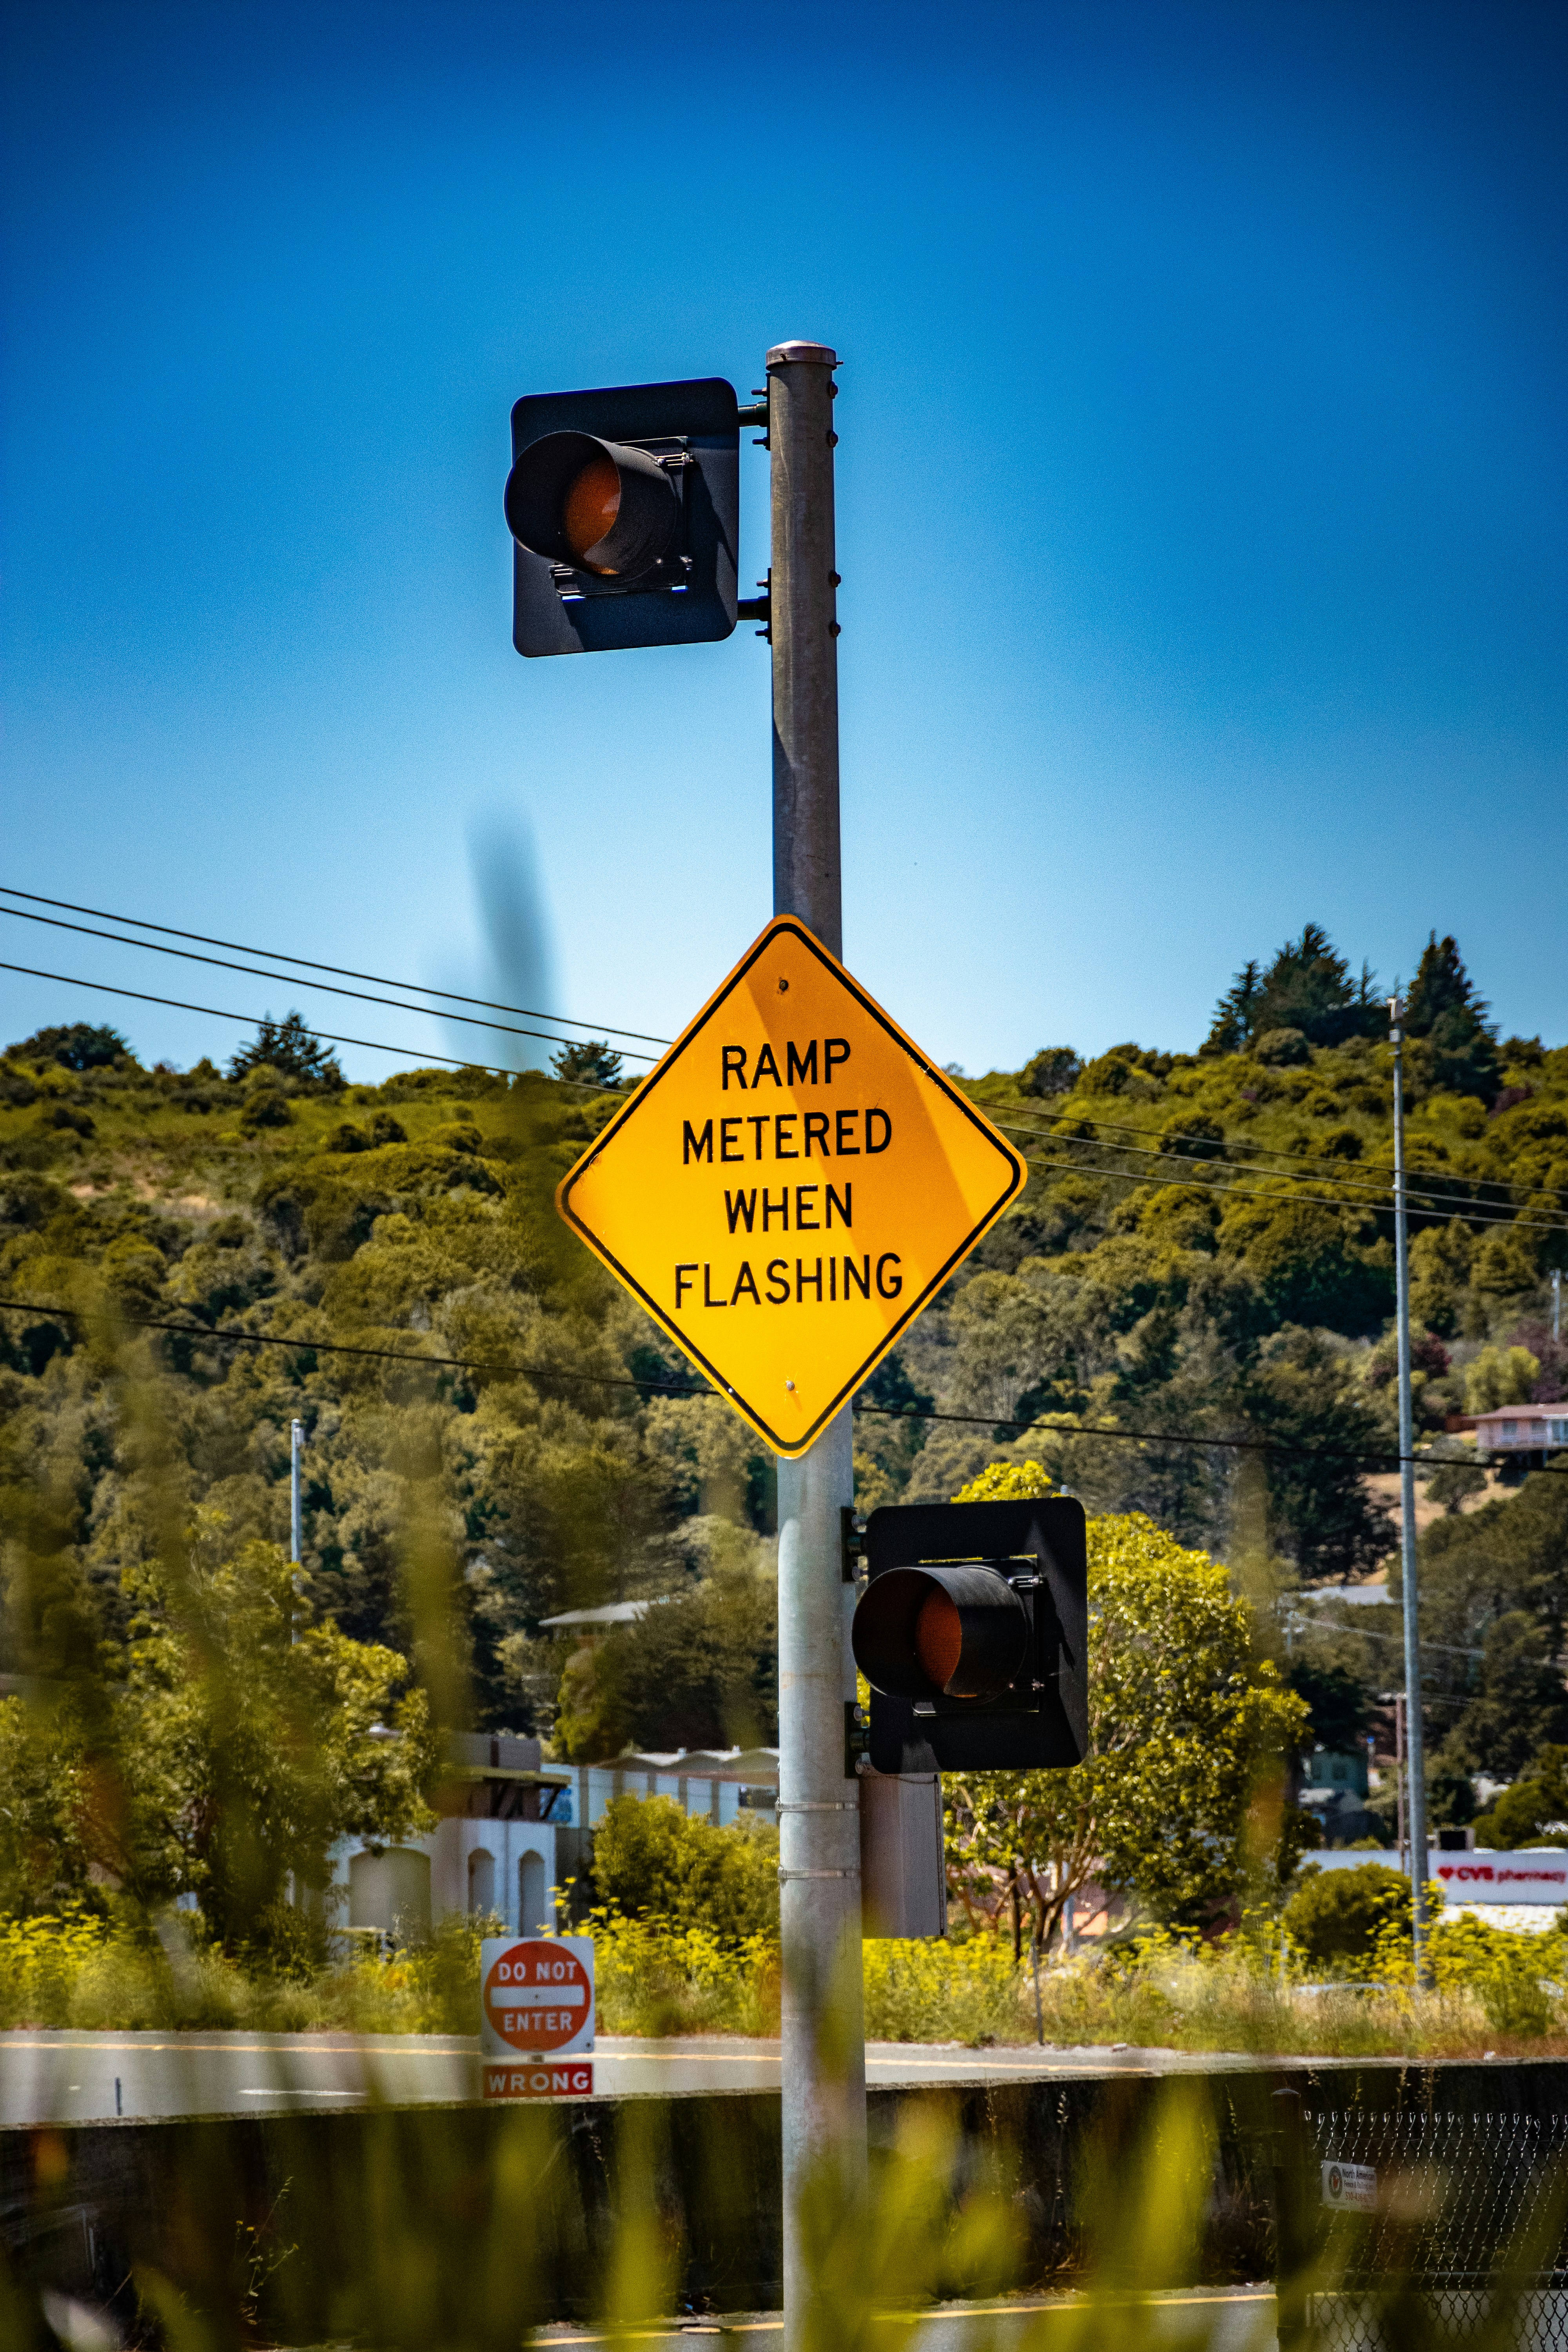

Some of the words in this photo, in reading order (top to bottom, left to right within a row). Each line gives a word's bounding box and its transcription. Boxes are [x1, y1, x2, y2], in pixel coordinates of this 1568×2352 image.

[721, 1038, 851, 1090] RAMP
[682, 1108, 892, 1165] METERED
[724, 1182, 852, 1234] WHEN
[675, 1252, 903, 1309] FLASHING
[1456, 1866, 1494, 1881] CVS
[1497, 1869, 1566, 1885] pharmacy
[498, 1962, 526, 1981] DO
[536, 1961, 577, 1980] NOT
[504, 2012, 573, 2032] ENTER
[488, 2071, 589, 2092] WRONG
[1342, 2168, 1355, 2179] North
